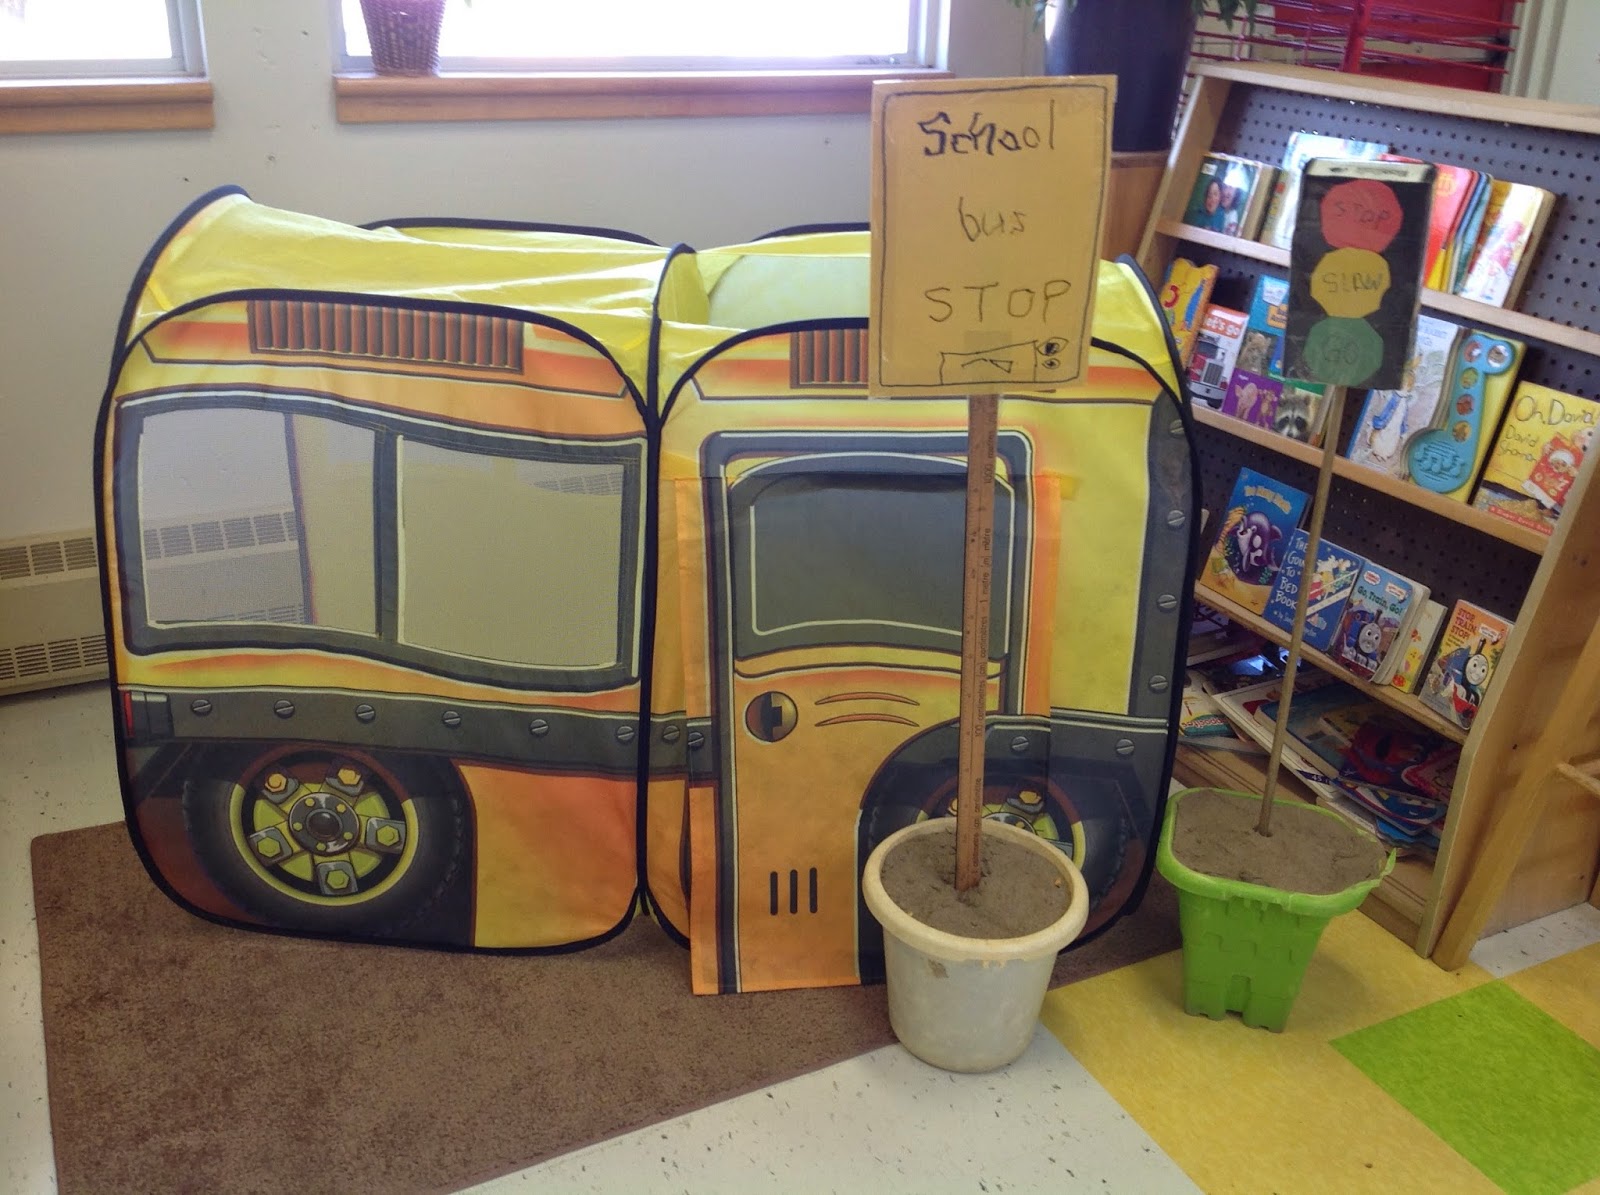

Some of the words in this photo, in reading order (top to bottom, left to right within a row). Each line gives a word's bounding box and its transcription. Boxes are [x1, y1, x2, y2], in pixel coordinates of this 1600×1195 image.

[918, 99, 1055, 156] School
[958, 196, 1027, 242] bus
[1335, 201, 1391, 231] STOP
[924, 279, 1071, 325] STOP
[1295, 536, 1309, 553] THE
[1285, 566, 1296, 578] TO
[1280, 576, 1298, 594] BED
[1275, 590, 1298, 610] BOOK
[975, 724, 983, 738] 100
